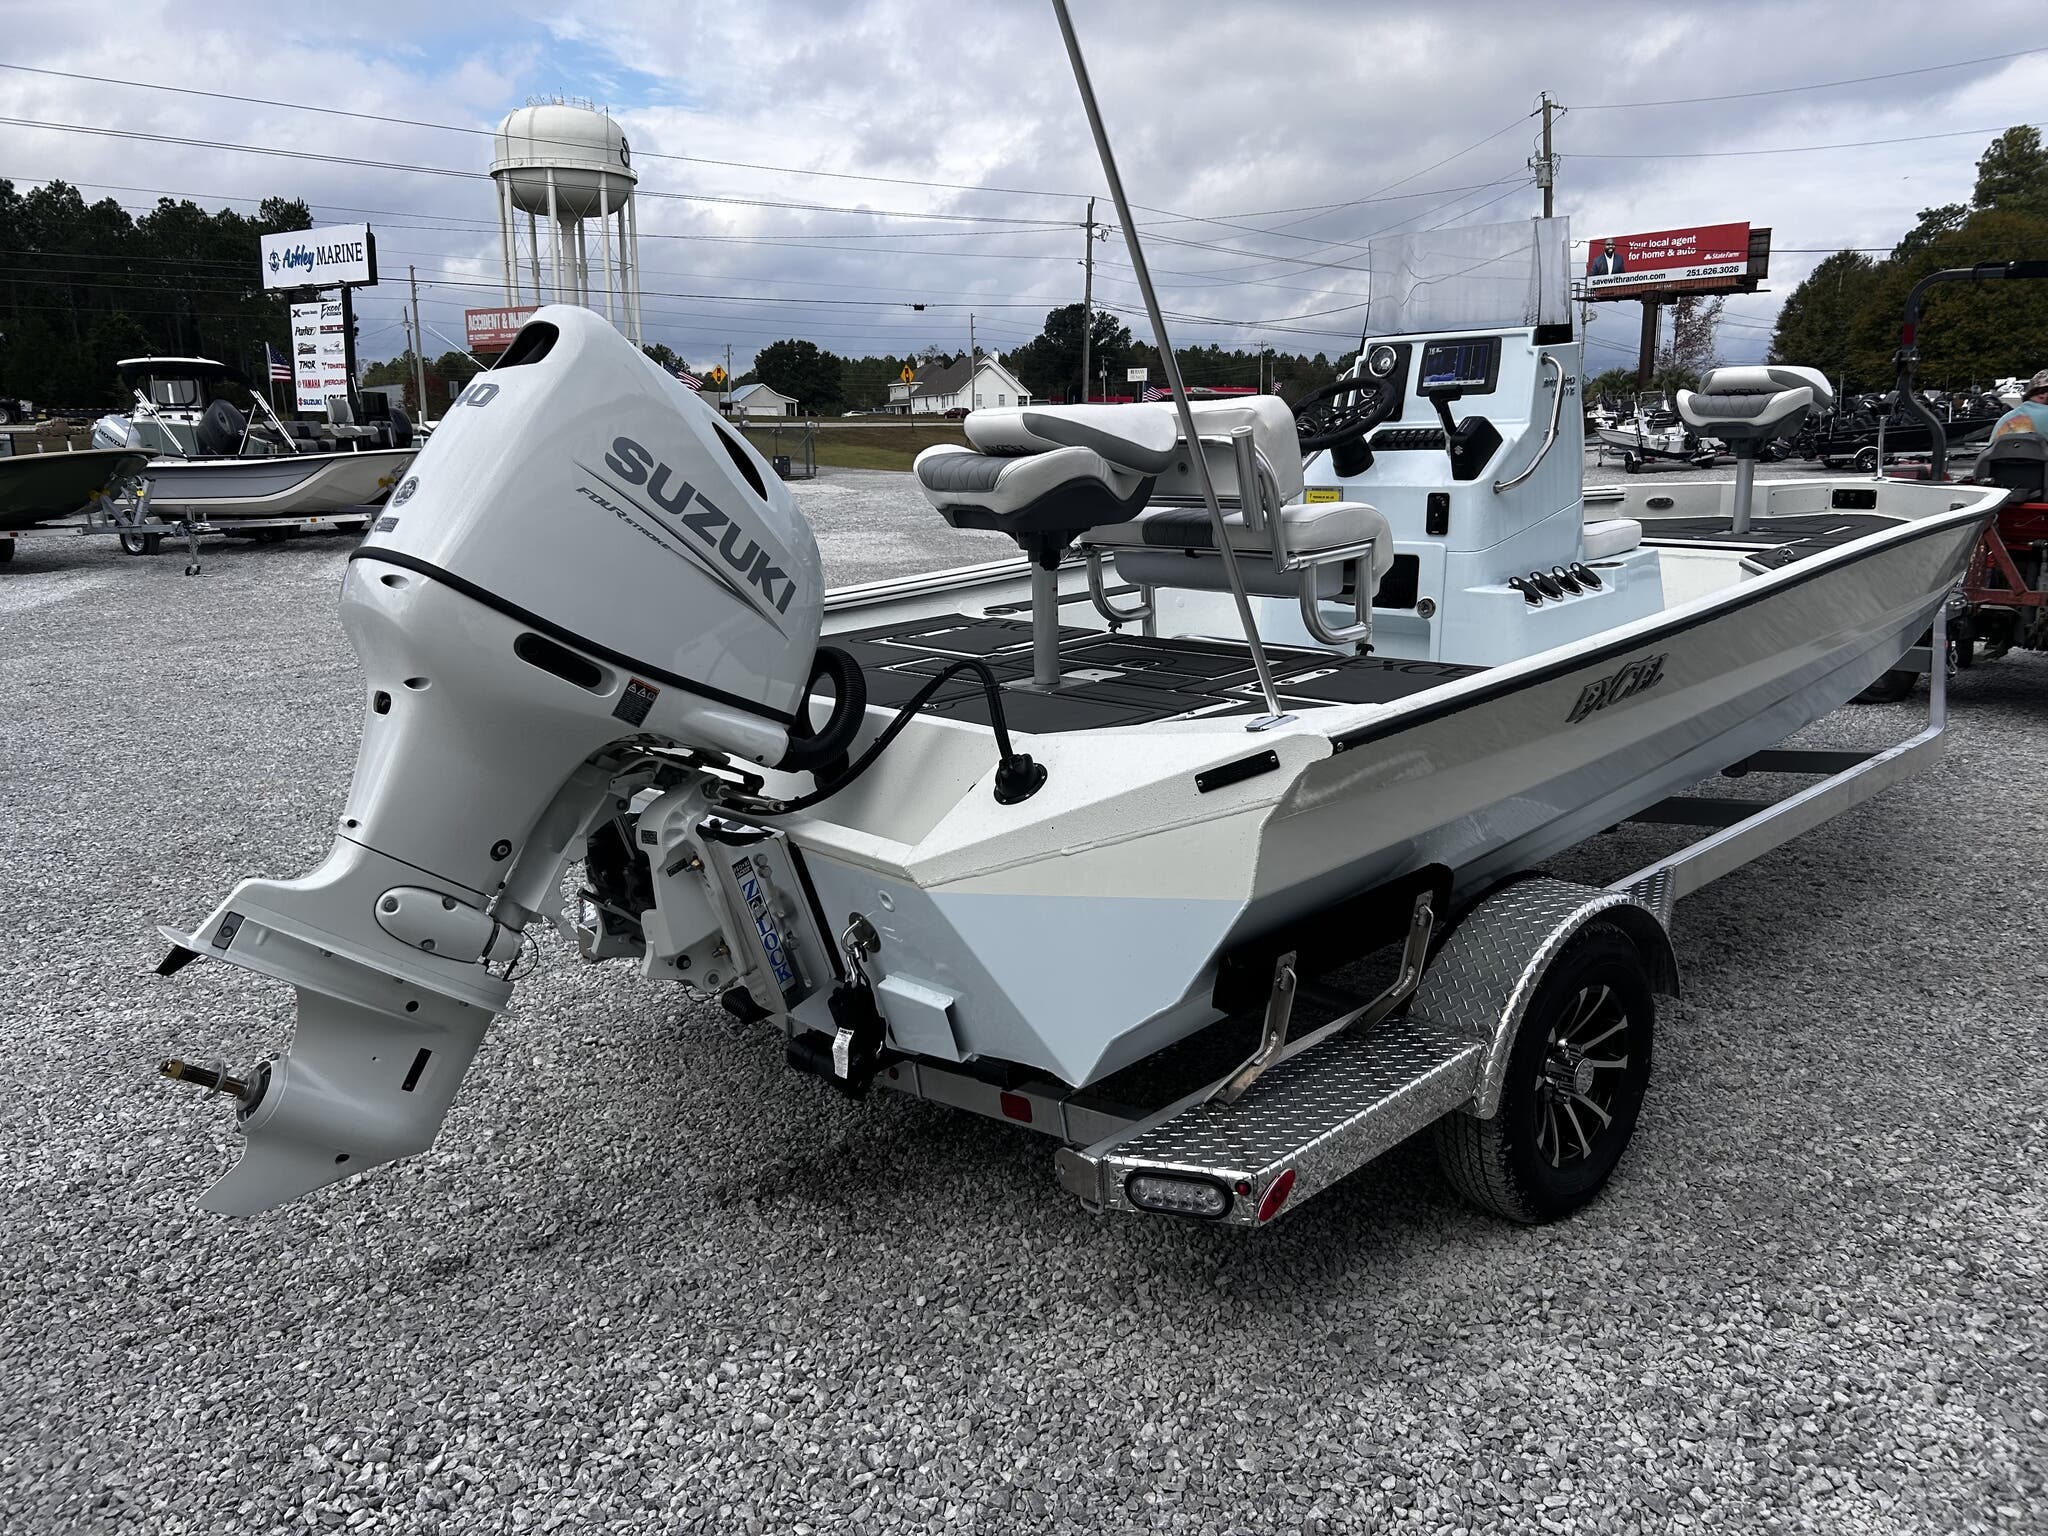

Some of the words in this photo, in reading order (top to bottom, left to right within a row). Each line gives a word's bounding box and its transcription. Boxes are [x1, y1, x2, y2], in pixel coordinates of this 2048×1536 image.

[1629, 241, 1647, 249] Your
[1649, 237, 1669, 248] local
[1671, 235, 1696, 246] agent
[283, 244, 314, 272] Ashley
[316, 242, 363, 266] MARINE
[1628, 252, 1640, 261] for
[1642, 251, 1665, 260] home
[1667, 249, 1675, 257] &
[1677, 247, 1696, 256] auto
[1686, 266, 1739, 277] 251.626.3026
[1592, 272, 1665, 286] savewithrandon.com
[501, 313, 508, 329] &
[302, 379, 320, 389] YAMAHA
[604, 436, 797, 615] SUZUKI
